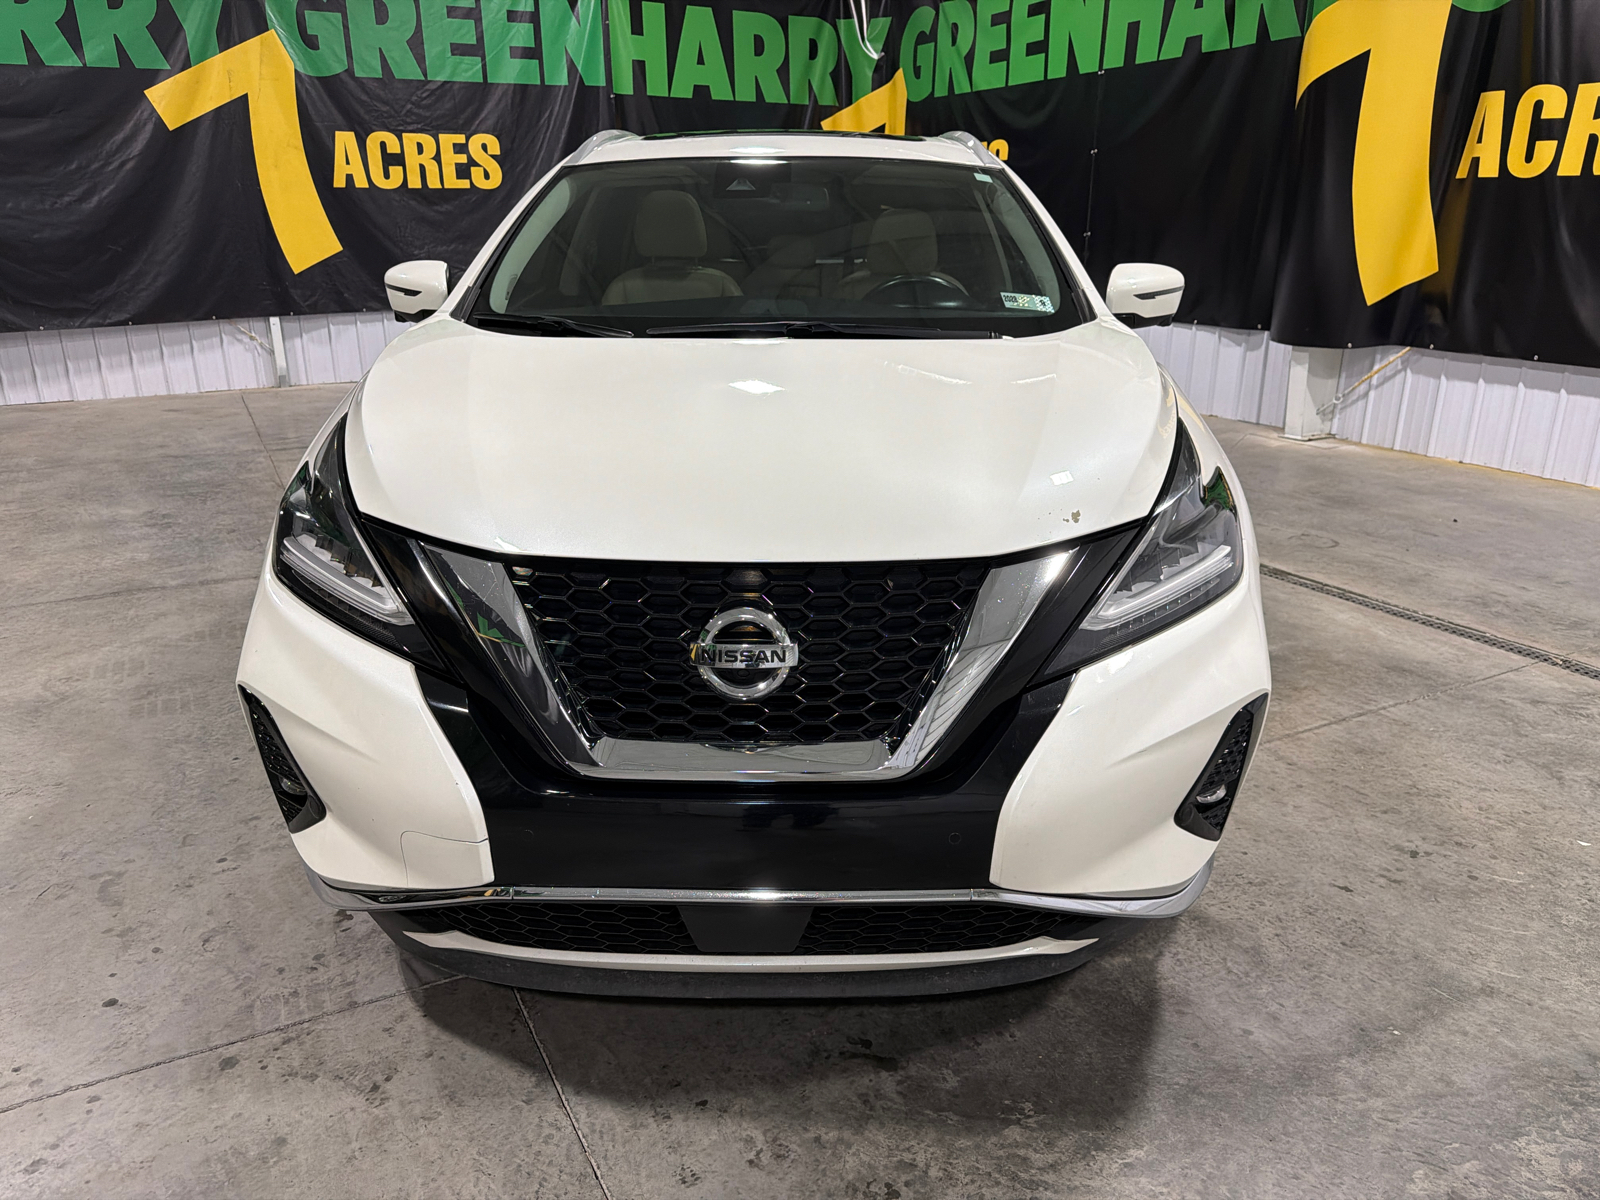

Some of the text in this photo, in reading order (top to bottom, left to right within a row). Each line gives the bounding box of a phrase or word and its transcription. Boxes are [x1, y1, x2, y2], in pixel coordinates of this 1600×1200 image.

[265, 0, 606, 87] GREEN
[608, 0, 892, 106] HARRY
[900, 0, 1102, 102] GREEN
[143, 29, 503, 275] 7 ACRES
[1295, 0, 1452, 306] 7
[701, 649, 787, 663] NISSAN
